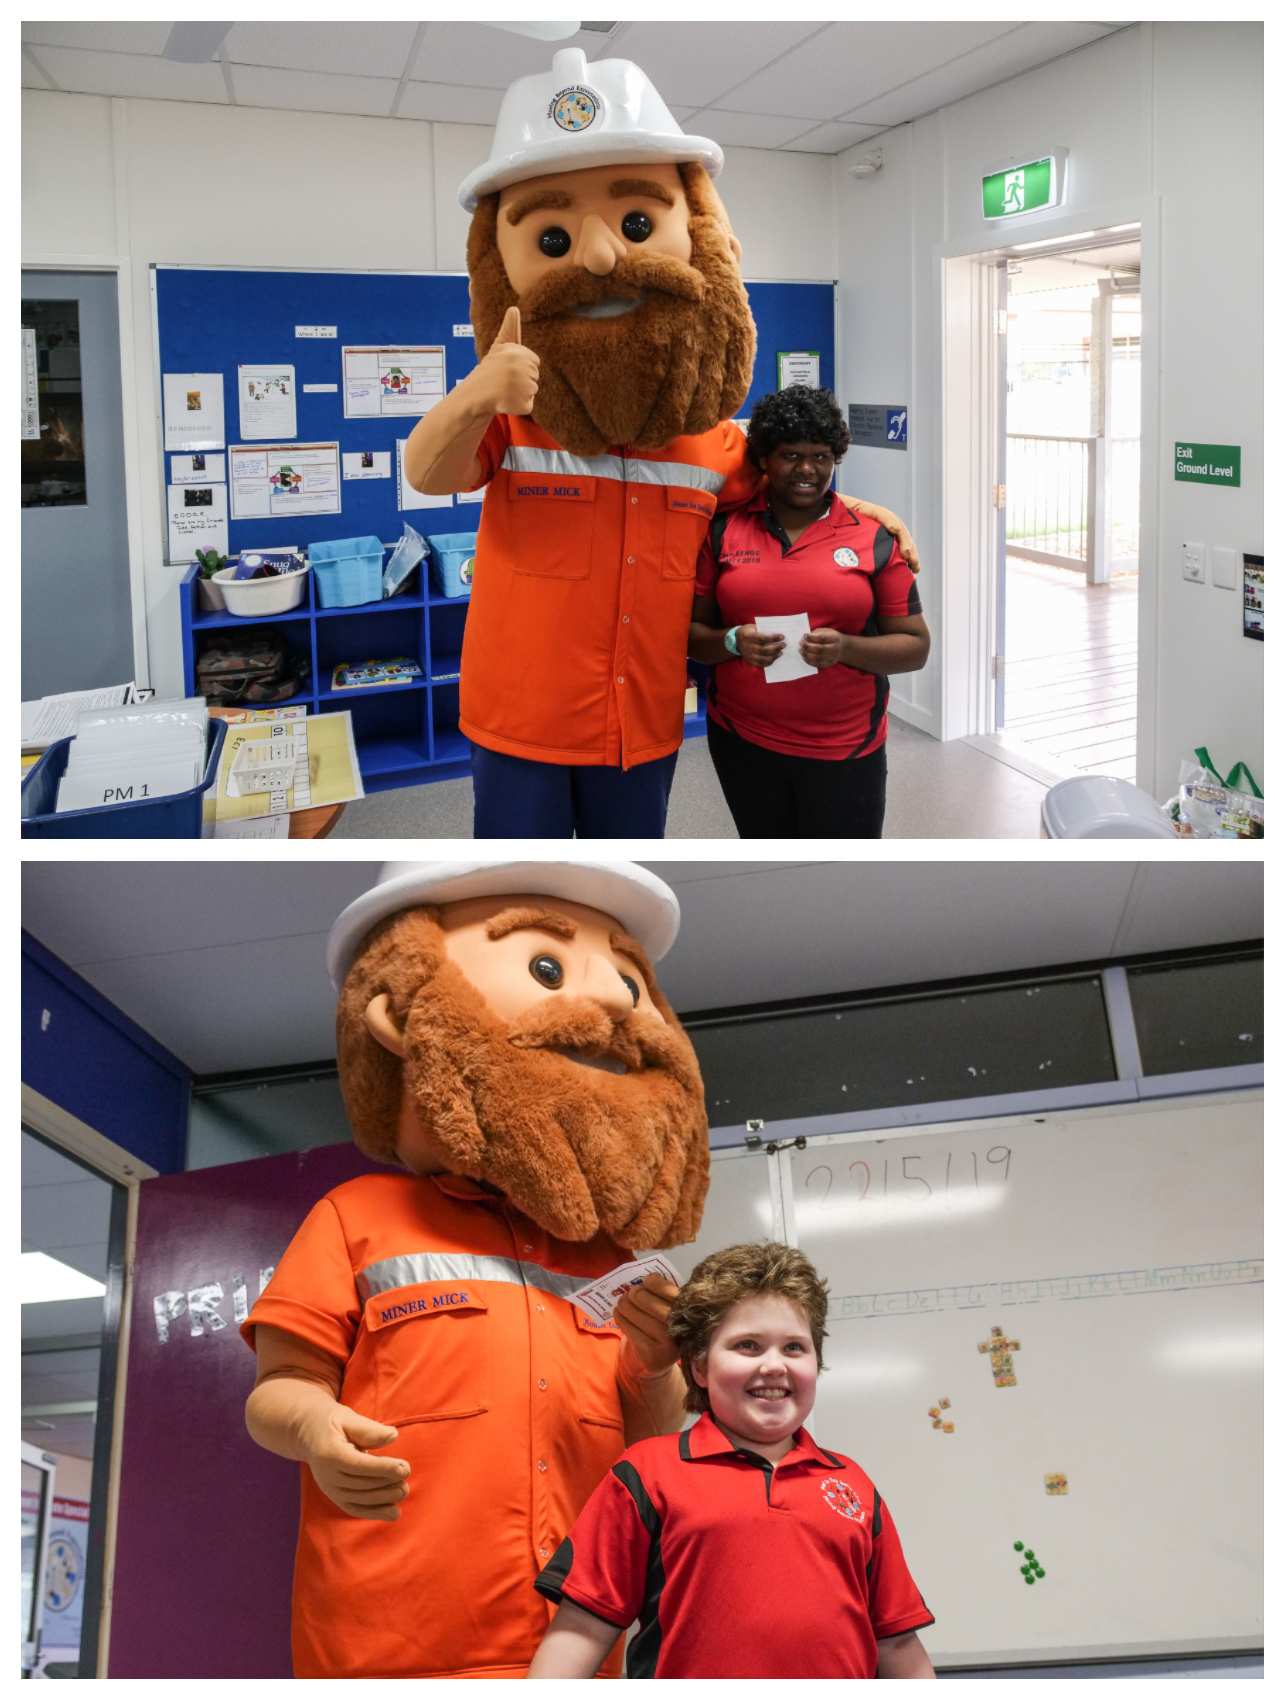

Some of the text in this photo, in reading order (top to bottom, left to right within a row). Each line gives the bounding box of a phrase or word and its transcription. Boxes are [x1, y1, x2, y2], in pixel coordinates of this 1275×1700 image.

[1176, 446, 1193, 459] Exit
[1176, 461, 1233, 477] Ground Level
[517, 486, 580, 496] MINER MICK
[103, 783, 151, 803] PM 1
[154, 1264, 274, 1344] PRI
[381, 1292, 468, 1322] MINER MICK
